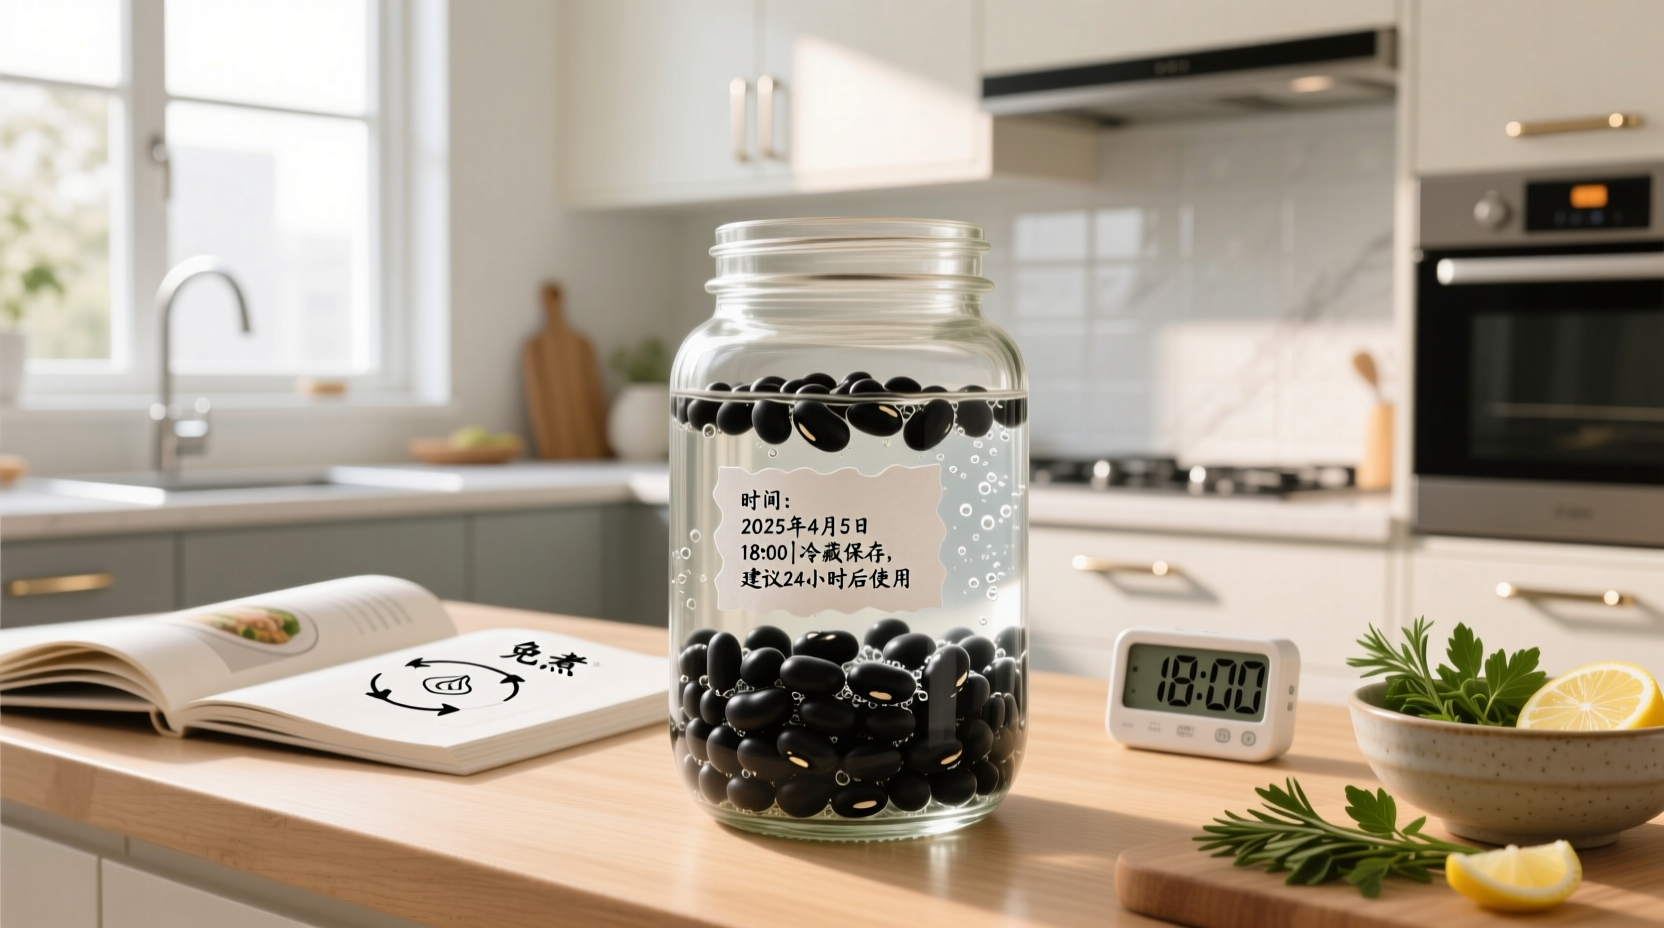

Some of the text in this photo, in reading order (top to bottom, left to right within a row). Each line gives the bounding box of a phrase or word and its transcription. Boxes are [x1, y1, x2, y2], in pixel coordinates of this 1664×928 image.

[741, 515, 868, 538] 2025年4月5日
[741, 567, 910, 589] 建议24小时后使用
[1156, 654, 1267, 715] 18:00
